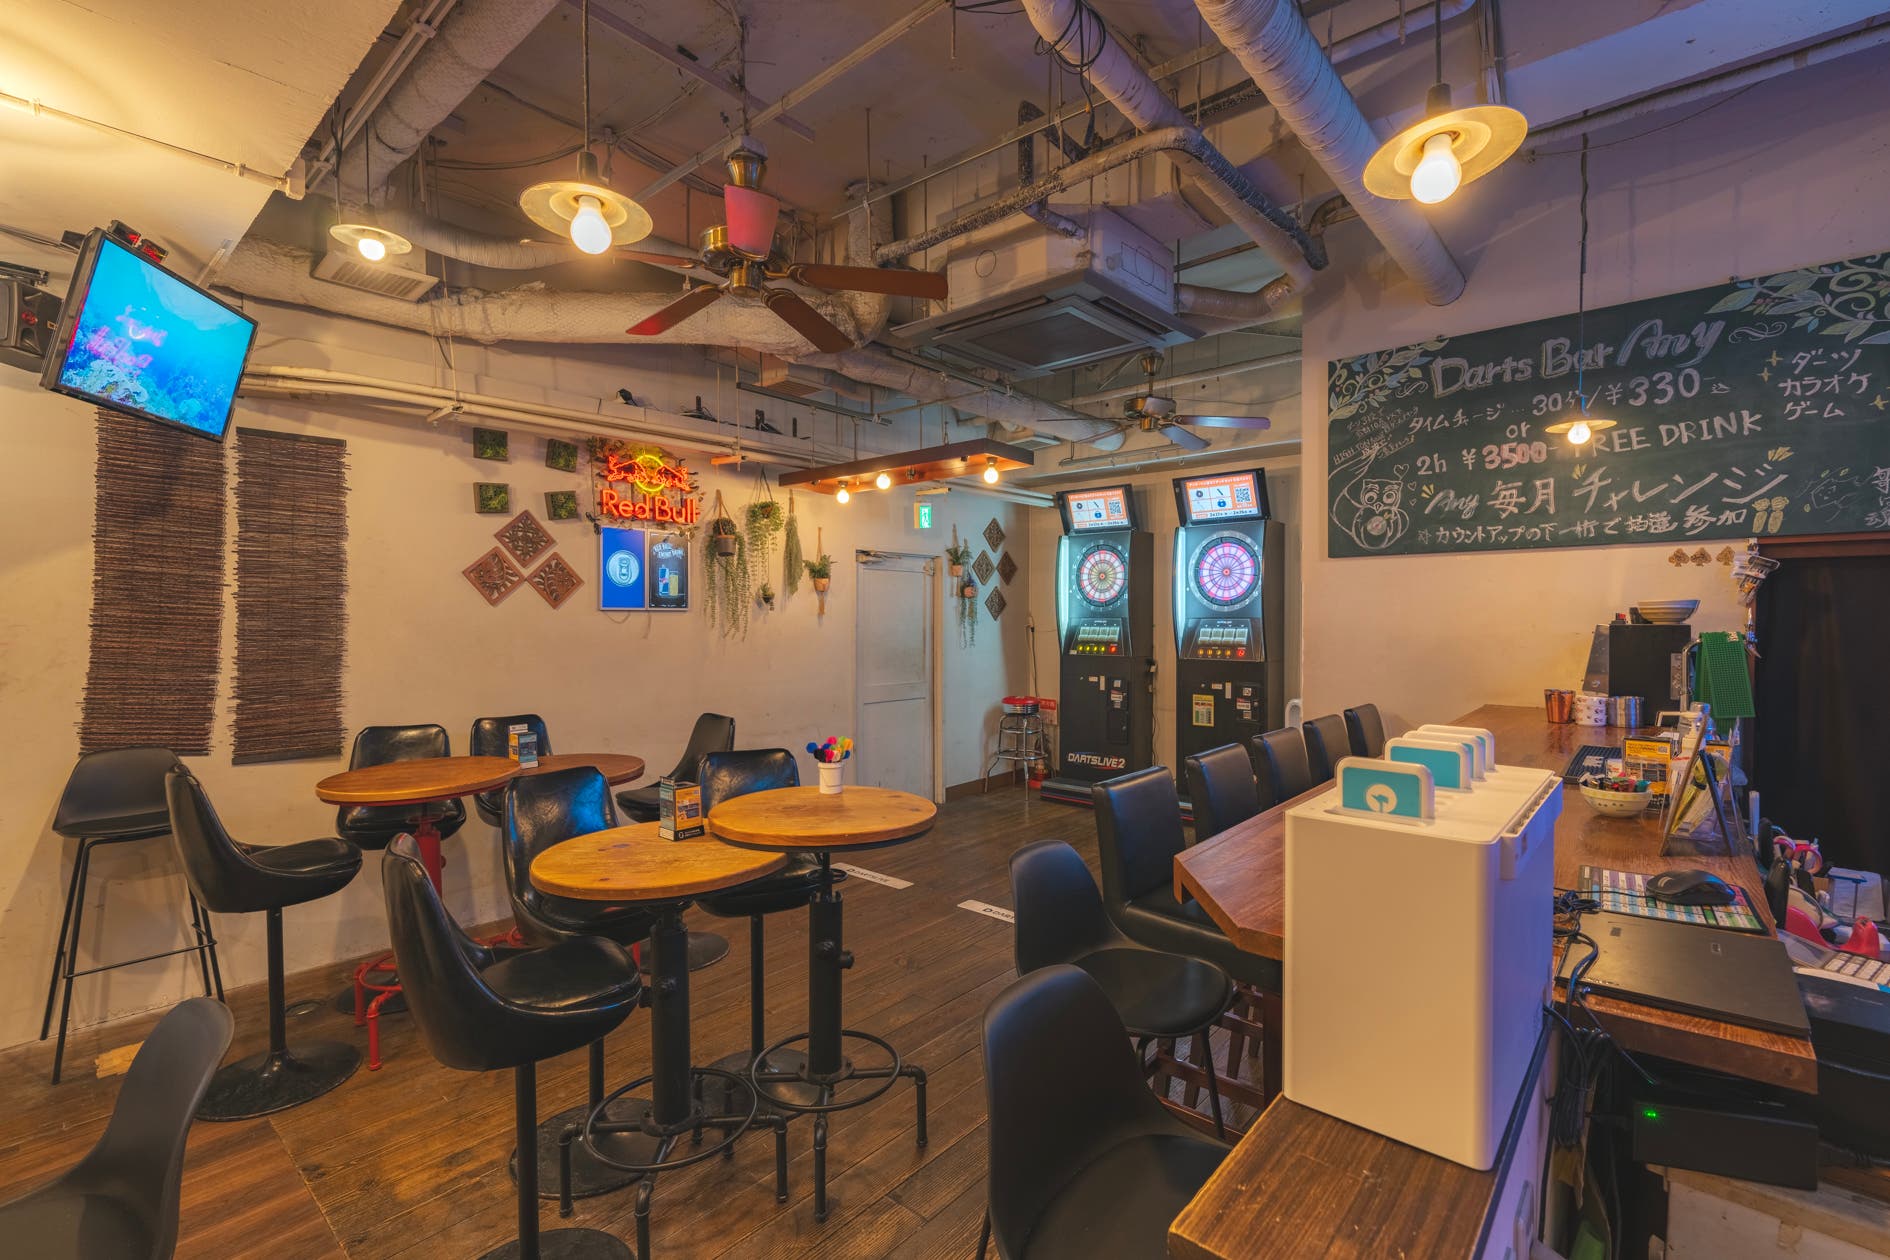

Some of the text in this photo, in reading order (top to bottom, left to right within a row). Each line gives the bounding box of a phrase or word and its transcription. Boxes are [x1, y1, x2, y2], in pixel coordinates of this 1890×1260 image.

[1431, 318, 1727, 398] Darts Bar Any
[1791, 348, 1863, 375] ダーツ
[1777, 372, 1873, 398] カラオケ
[1783, 400, 1846, 421] ゲーム
[1416, 453, 1448, 476] 2h
[1658, 410, 1763, 448] DRINK
[1505, 421, 1532, 439] or
[602, 488, 697, 525] Red Bull
[1486, 477, 1557, 519] 毎月
[1572, 463, 1790, 513] チャレンジ
